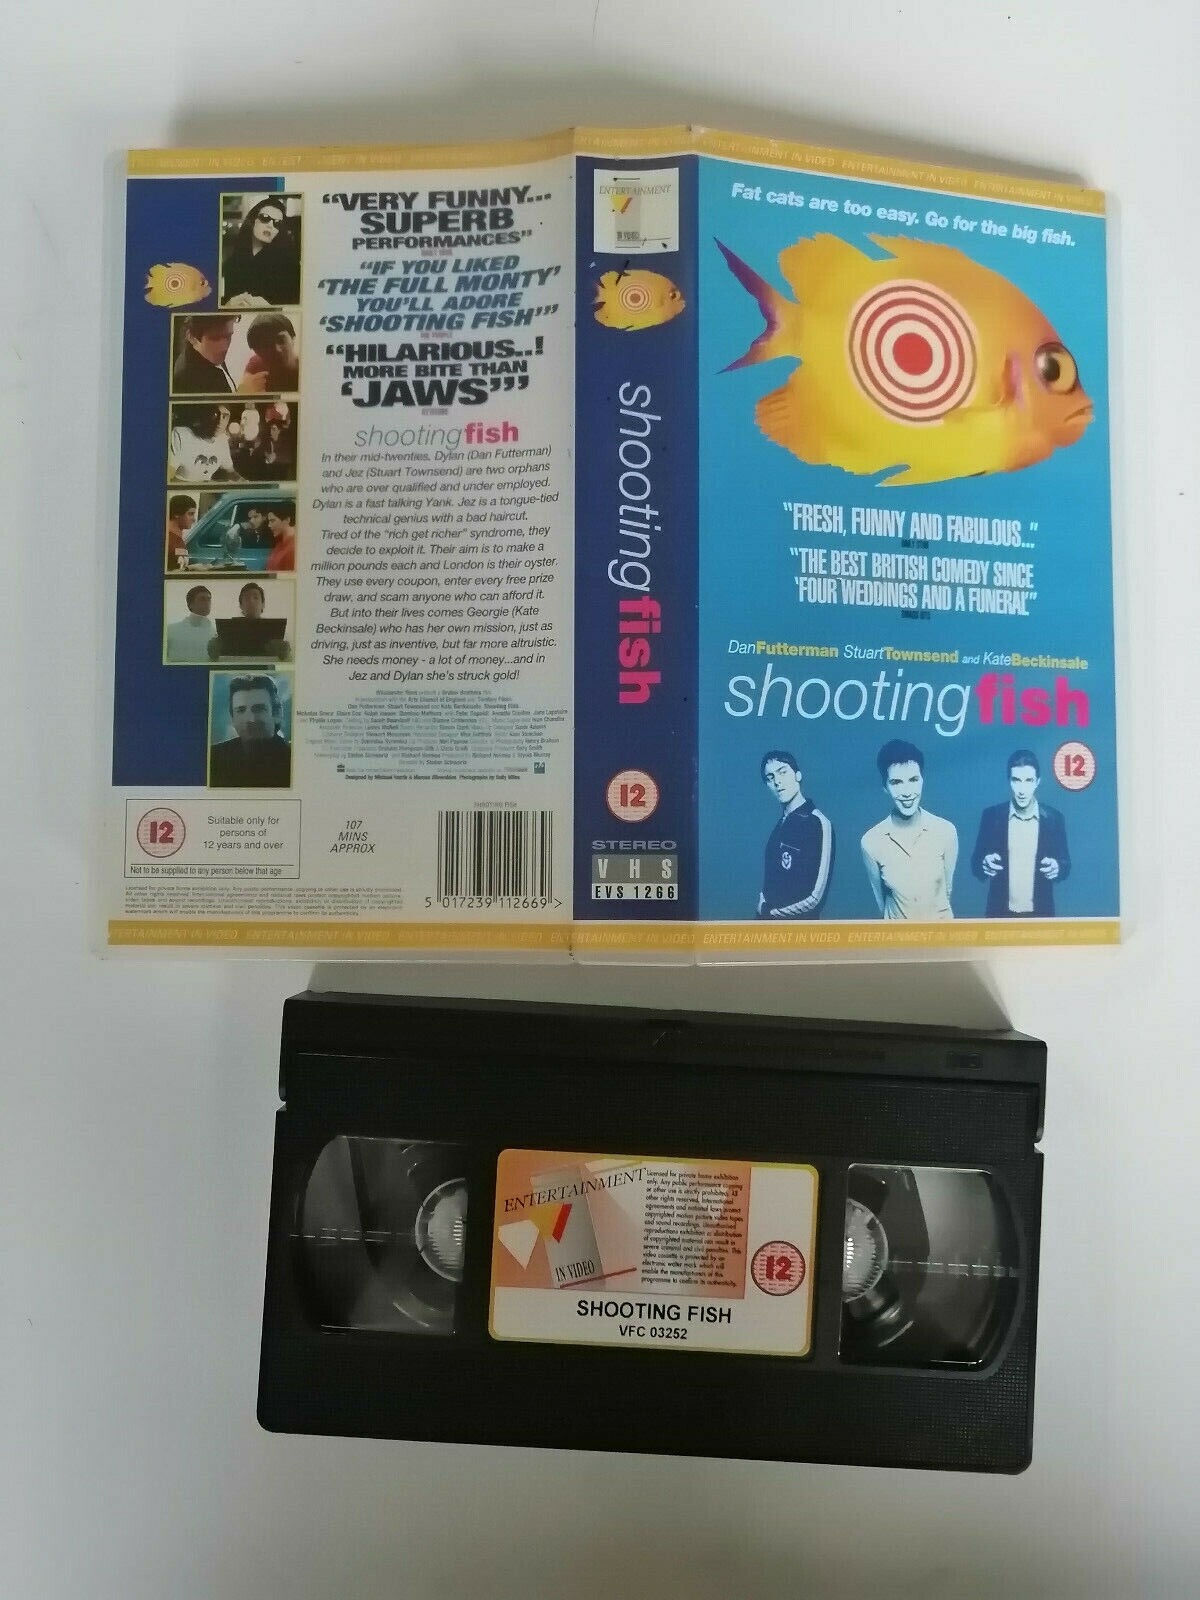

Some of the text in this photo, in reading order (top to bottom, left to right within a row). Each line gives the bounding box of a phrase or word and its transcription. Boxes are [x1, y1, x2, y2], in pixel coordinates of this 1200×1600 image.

[429, 185, 551, 209] FUNNY...
[360, 208, 514, 235] SUPERB
[732, 182, 1075, 246] Fat cats are too easy. Go for the big fish.
[402, 260, 448, 275] YOU
[452, 255, 520, 273] LIKED
[383, 277, 448, 294] FULL
[357, 292, 523, 312] YOU'LL ADORE
[343, 360, 527, 378] MORE BITE THAN
[852, 507, 905, 537] FUNNY
[910, 512, 942, 540] AND
[790, 548, 1034, 588] "THE BEST BRITISH COMEDY SINCE
[357, 593, 377, 601] and
[412, 593, 451, 604] anyone
[455, 592, 476, 600] who
[502, 590, 533, 600] afford
[839, 578, 918, 608] WEDDINGS
[922, 585, 951, 610] AND
[955, 587, 965, 611] A
[330, 606, 539, 618] But into their lives comes Georgie (Kate
[316, 624, 376, 635] Beckinsale)
[380, 624, 402, 633] who
[405, 624, 424, 633] has
[427, 623, 444, 632] her
[474, 623, 516, 633] mission,
[519, 622, 538, 634] just
[351, 641, 371, 651] just
[389, 640, 438, 649] inventive,
[442, 640, 460, 648] but
[464, 639, 477, 648] far
[511, 637, 556, 648] altruistic.
[323, 655, 343, 664] She
[346, 655, 379, 664] needs
[382, 656, 418, 666] money
[439, 655, 451, 664] lot
[455, 655, 466, 664] of
[536, 653, 545, 663] in
[963, 654, 979, 664] and
[349, 670, 520, 682] Jez and Dylan she's struck gold!
[1064, 755, 1085, 777] 12
[620, 784, 645, 807] 12
[208, 816, 279, 826] Suitable only for
[346, 821, 362, 829] 107
[150, 821, 173, 843] 12
[339, 832, 368, 841] MINS
[217, 842, 241, 850] years
[244, 841, 260, 849] and
[330, 844, 376, 853] APPROX
[592, 841, 677, 850] STEREO
[161, 867, 188, 876] supplied
[198, 868, 209, 876] any
[211, 868, 233, 876] person
[595, 886, 674, 898] EVS 1266
[425, 897, 432, 908] 5
[442, 897, 491, 908] 017239
[504, 1168, 647, 1212] ENTERTAINMENT
[555, 1259, 595, 1282] IN VIDEO
[765, 1255, 793, 1280] 12
[577, 1300, 732, 1323] SHOOTING FISH
[619, 1325, 687, 1339] VFC 03252
